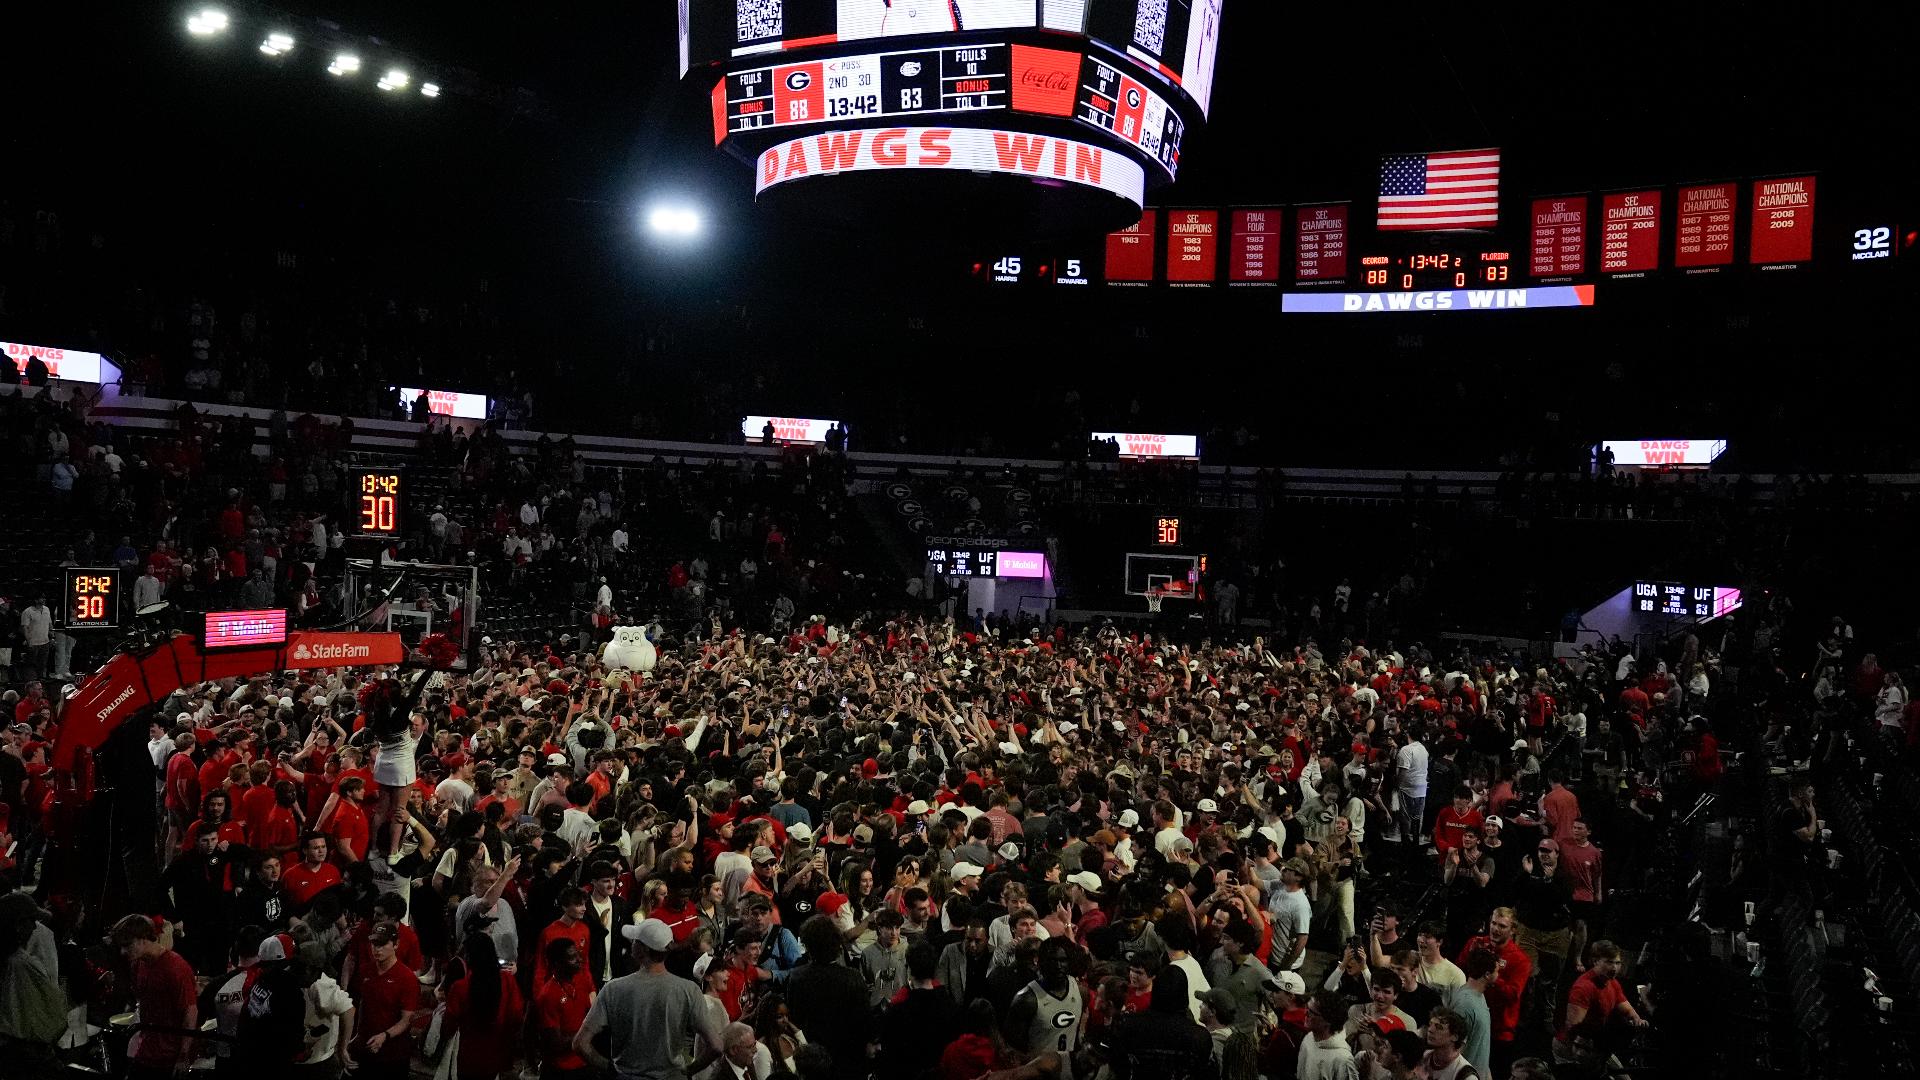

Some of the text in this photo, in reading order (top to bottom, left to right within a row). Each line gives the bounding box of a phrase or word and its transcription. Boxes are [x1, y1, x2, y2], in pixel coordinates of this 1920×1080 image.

[956, 49, 986, 62] FOULS
[966, 62, 977, 75] 10
[740, 72, 762, 86] FOULS
[829, 73, 871, 89] 2ND 30
[956, 80, 989, 92] BONUS
[901, 88, 922, 109] 83
[790, 99, 808, 120] 88
[829, 95, 877, 117] 13:42
[764, 129, 1103, 185] DAWGS WIN
[1688, 188, 1726, 201] NATIONAL
[1763, 182, 1805, 195] NATIONAL
[1624, 196, 1639, 206] SEC
[1683, 199, 1729, 213] CHAMPIONS
[1759, 193, 1808, 207] CHAMPIONS
[1552, 202, 1566, 213] SEC
[1608, 206, 1654, 219] CHAMPIONS
[1187, 214, 1199, 224] SEC
[1247, 212, 1266, 222] FINAL
[1316, 210, 1328, 220] SEC
[1537, 212, 1580, 225] CHAMPIONS
[1771, 210, 1795, 219] 2008
[1247, 222, 1265, 232] FOUR
[1301, 219, 1341, 231] CHAMPIONS
[1607, 221, 1654, 231] 2001 2008
[1682, 217, 1702, 225] 1987
[1770, 220, 1794, 229] 2009
[1122, 223, 1139, 233] OUR
[1173, 223, 1212, 233] CHAMPIONS
[1707, 224, 1729, 232] 2005
[1325, 233, 1343, 241] 1997
[1606, 232, 1627, 240] 2002
[1681, 234, 1729, 243] 1993 2006
[1854, 227, 1890, 250] 32
[1561, 245, 1580, 253] 1997
[1606, 241, 1627, 249] 2004
[1706, 244, 1728, 252] 2007
[1363, 252, 1509, 269] GEORGIA 13:42 2 FLORIDA
[1606, 251, 1627, 259] 2005
[1852, 250, 1889, 260] MCCLAIN
[994, 257, 1021, 274] 45
[1067, 260, 1080, 276] 5
[1605, 260, 1627, 268] 2006
[1368, 266, 1508, 288] 88 0 0 83
[1344, 289, 1527, 312] DAWGS WIN
[9, 344, 64, 360] DAWGS
[13, 358, 58, 375] WN
[771, 418, 811, 427] DAWGS
[775, 427, 807, 439] WIN
[1125, 434, 1167, 443] DAWGS
[1128, 443, 1162, 454] WIN
[1641, 441, 1690, 450] DAWGS
[1645, 451, 1685, 463] WIN
[362, 474, 398, 494] 13:42
[362, 495, 393, 530] 30
[1158, 518, 1179, 528] 13:42
[1158, 527, 1177, 542] 30
[978, 552, 994, 563] UF
[980, 565, 991, 575] 83
[76, 576, 111, 593] 13:42
[1636, 584, 1657, 596] UGA
[1694, 587, 1711, 600] UF
[78, 595, 103, 618] 30
[1641, 600, 1653, 611] 88
[1695, 604, 1707, 615] 83
[97, 685, 136, 722] SPALDING
[1051, 1010, 1076, 1029] G
